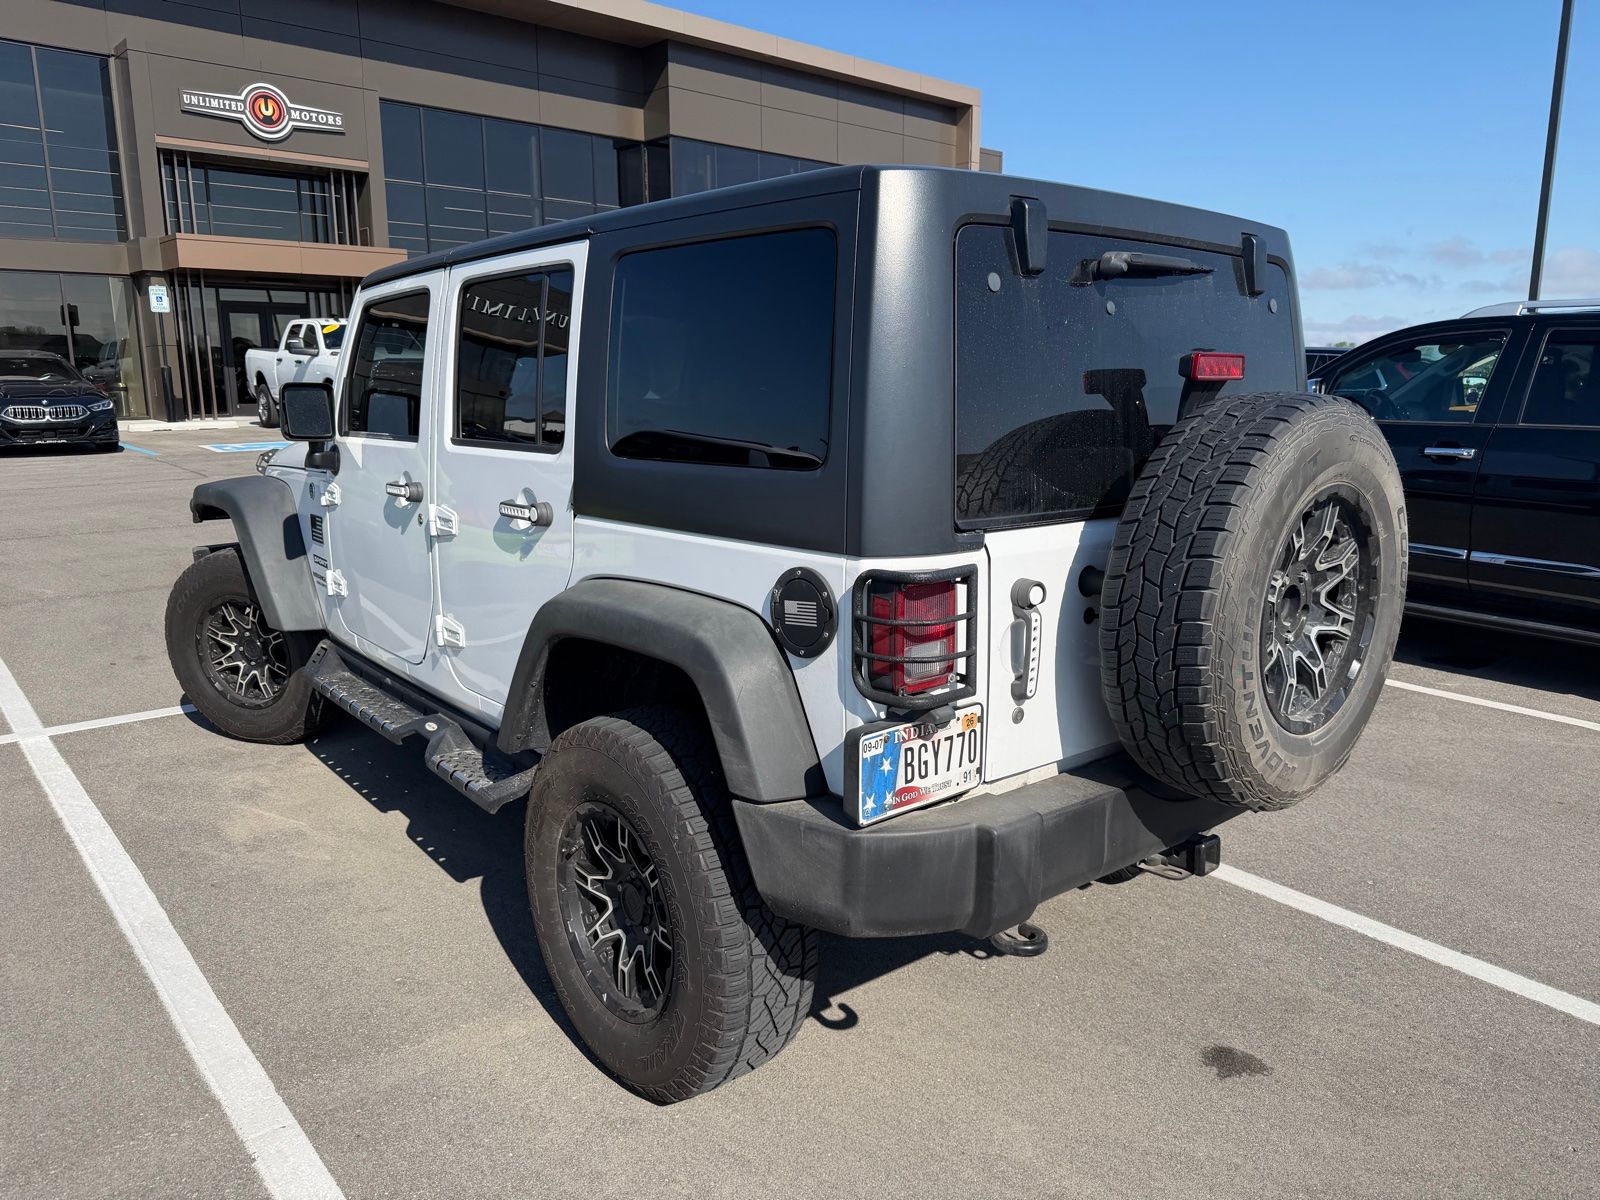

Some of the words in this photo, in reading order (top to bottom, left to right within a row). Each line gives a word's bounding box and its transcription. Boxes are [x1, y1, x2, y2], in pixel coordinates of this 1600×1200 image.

[183, 94, 244, 112] UNLIMITED
[291, 109, 343, 126] MOTORS
[966, 716, 974, 729] 26
[863, 738, 883, 754] 09-07
[904, 729, 977, 785] BGY770
[963, 770, 972, 783] 91
[901, 790, 918, 802] GOD
